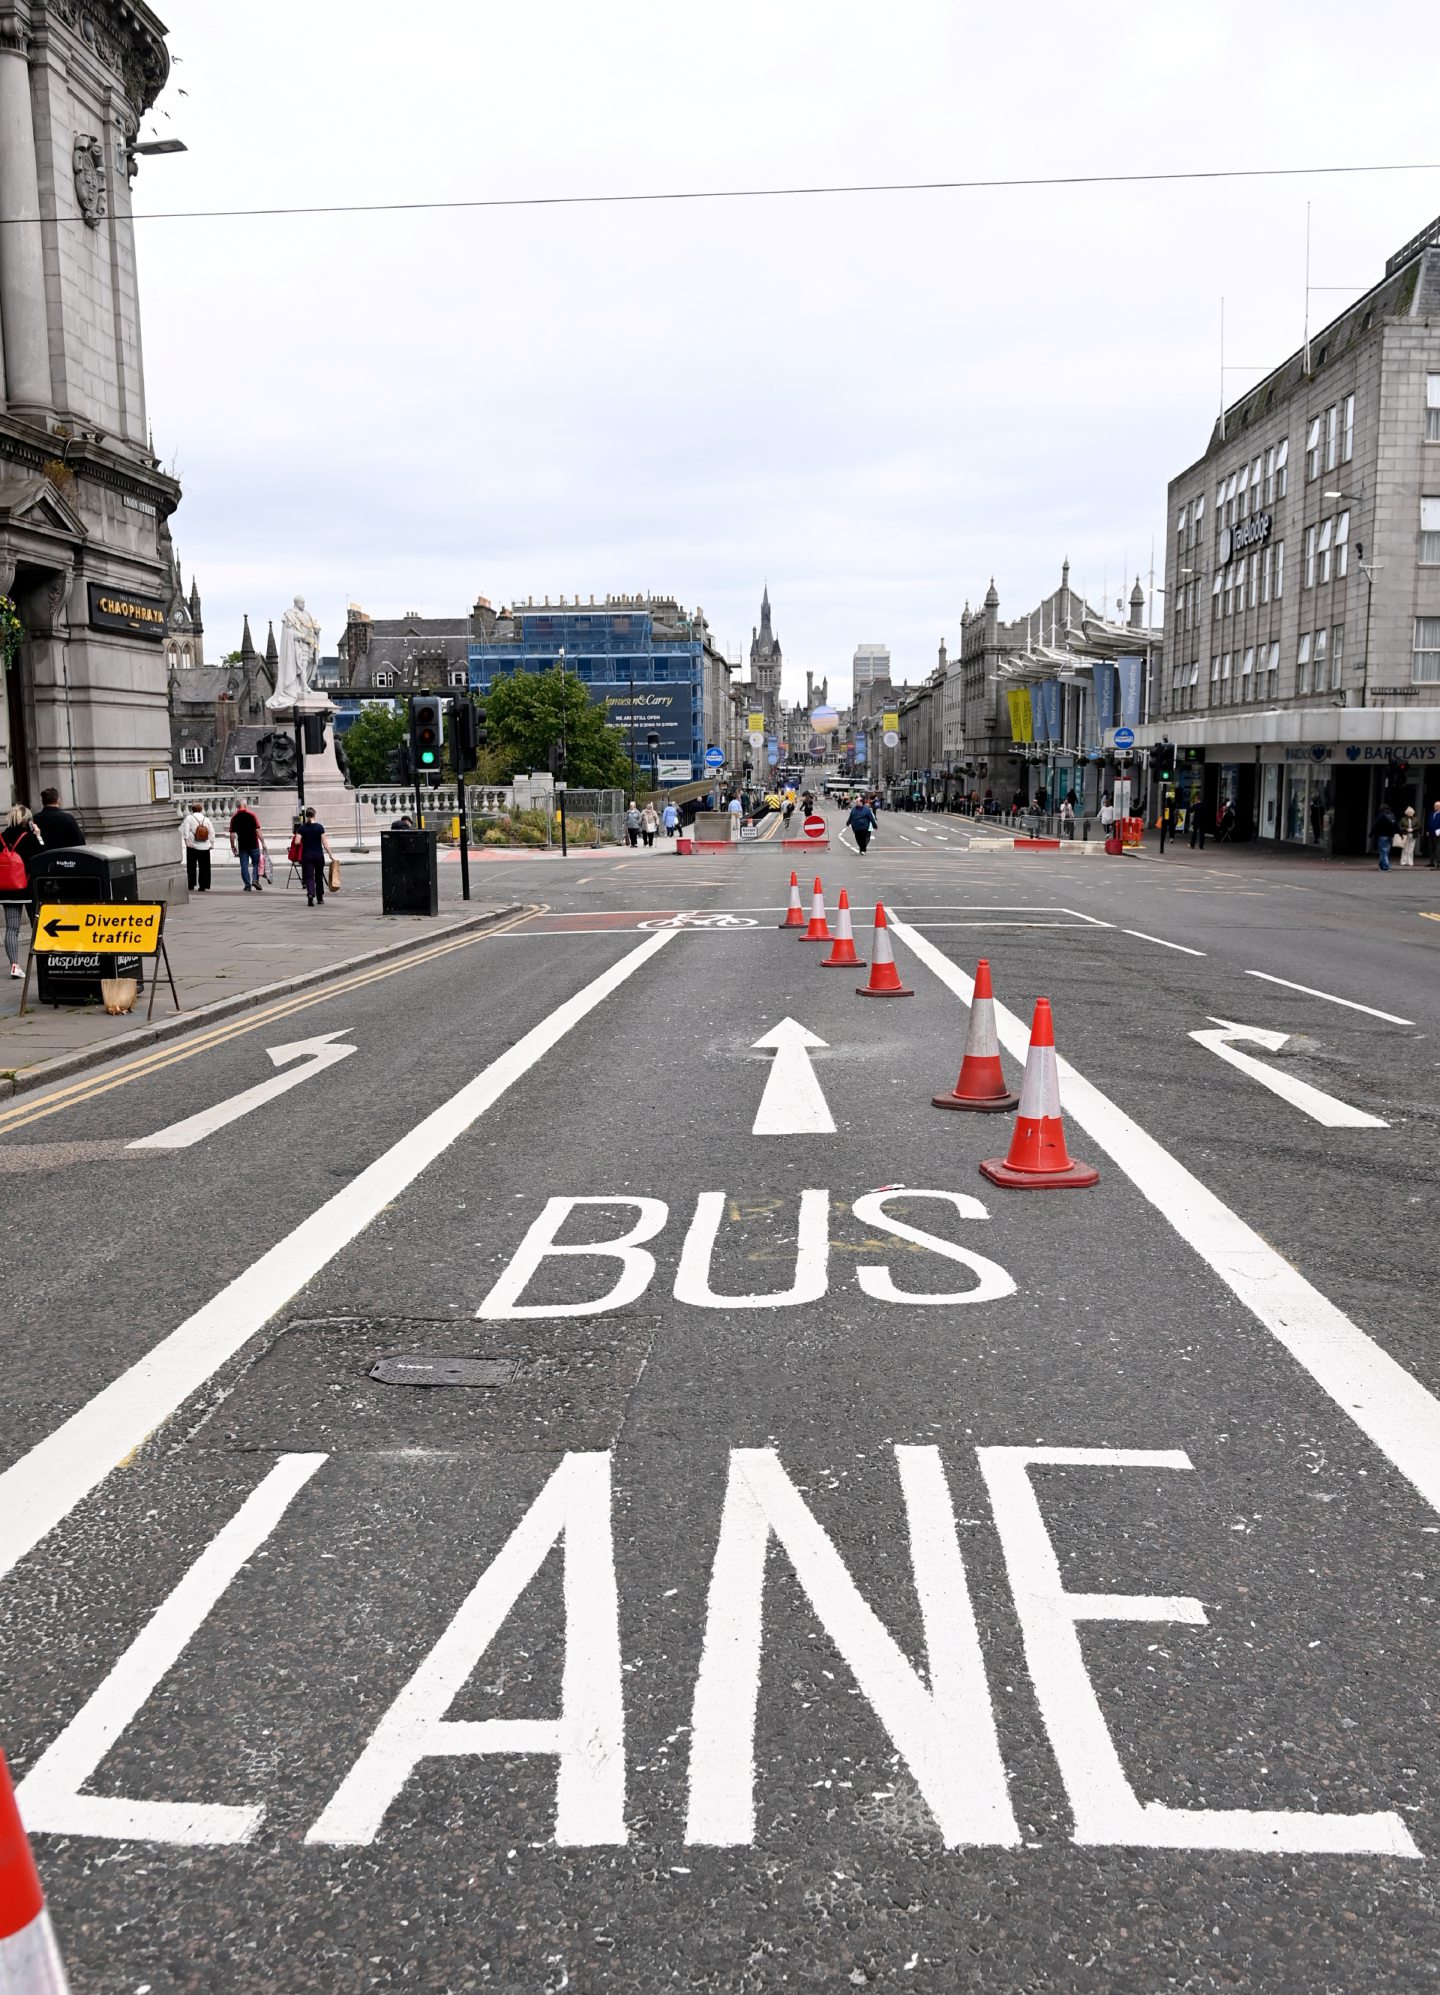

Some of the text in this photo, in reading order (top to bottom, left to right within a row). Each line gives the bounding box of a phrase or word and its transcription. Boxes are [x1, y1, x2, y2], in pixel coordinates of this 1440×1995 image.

[99, 597, 165, 624] CHAOPHRAYA
[1364, 747, 1436, 760] BARCLAYS
[85, 914, 154, 927] Diverted
[92, 931, 142, 943] traffic
[48, 953, 100, 969] inspired
[474, 1188, 1018, 1322] BUS
[15, 1444, 1422, 1858] LANE
